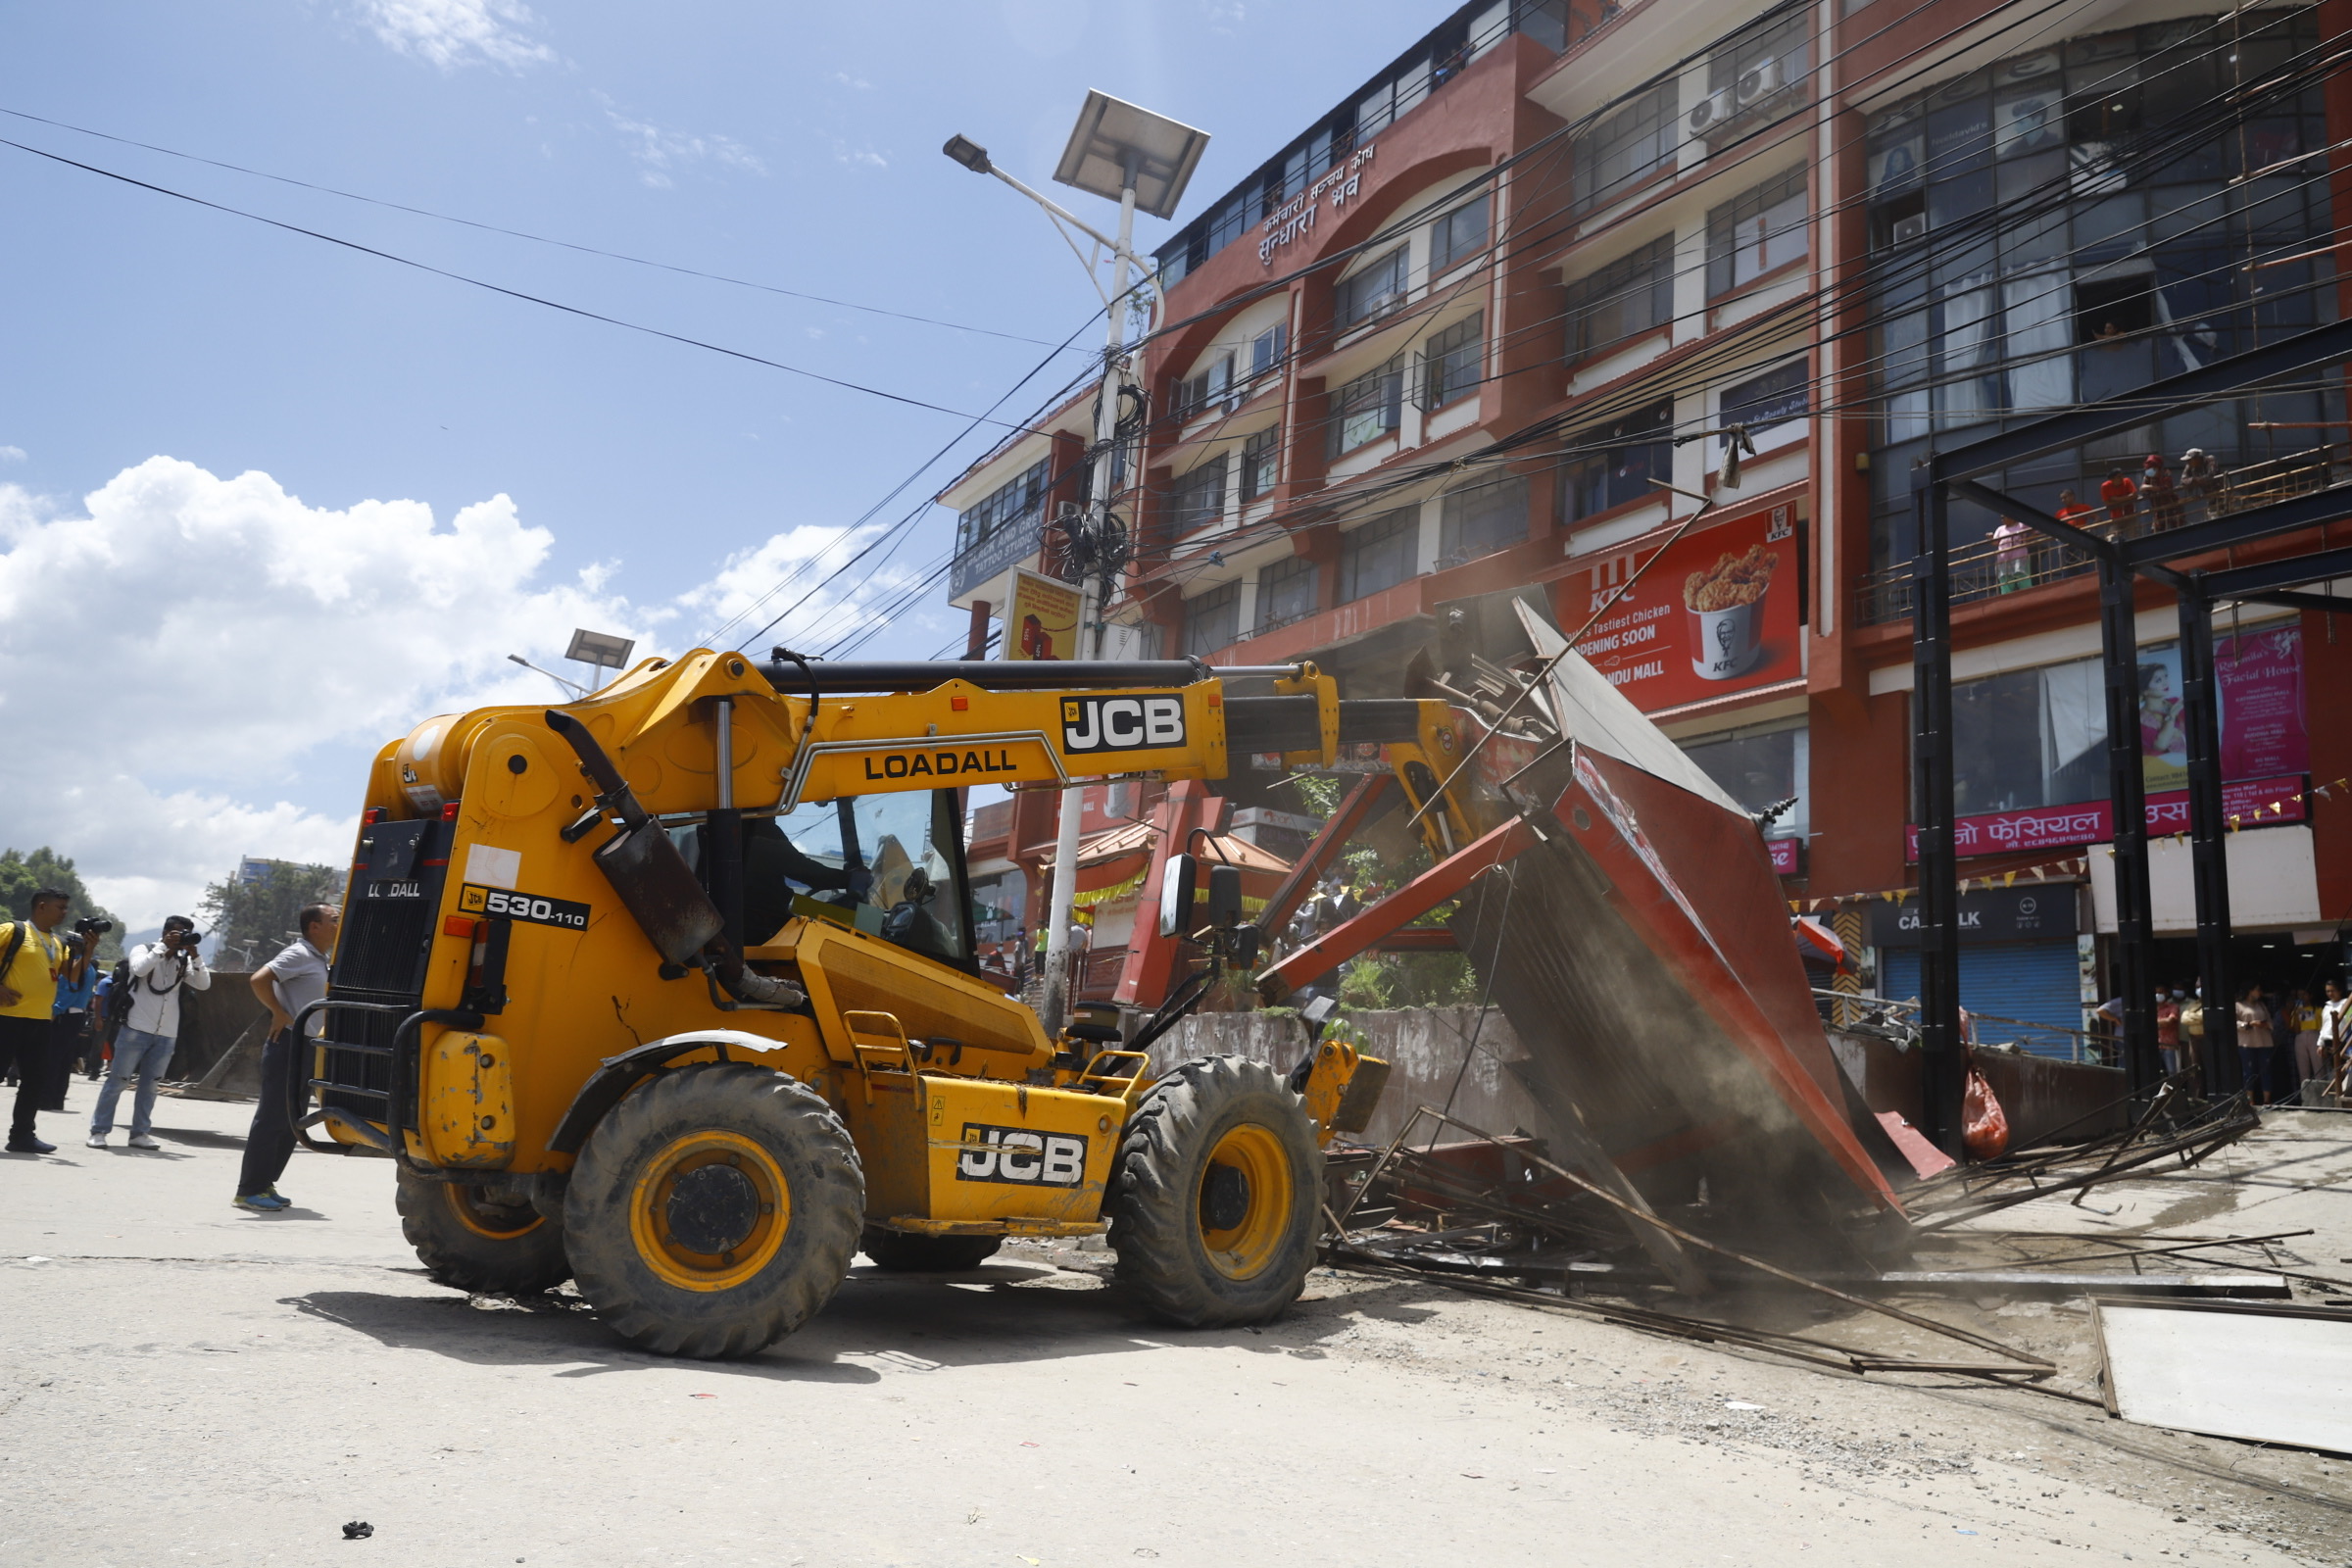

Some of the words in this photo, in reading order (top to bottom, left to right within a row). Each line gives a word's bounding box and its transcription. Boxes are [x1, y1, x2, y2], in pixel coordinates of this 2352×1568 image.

[1263, 193, 1304, 232] कर्मचारी
[1258, 203, 1317, 266] सुन्धारा
[998, 526, 1016, 548] AND
[1018, 508, 1045, 534] GREY
[1771, 529, 1789, 540] KFC
[975, 549, 1003, 575] TATTOO
[1004, 531, 1033, 558] STUDIO
[1593, 614, 1630, 635] Tastiest
[1633, 605, 1670, 623] Chicken
[1622, 624, 1656, 647] SOON
[1634, 660, 1664, 680] MALL
[2221, 668, 2260, 688] Facial
[2263, 666, 2301, 678] House
[1066, 698, 1183, 750] JCB
[864, 750, 1017, 780] LOADALL
[1987, 811, 2101, 841] फेसियल
[368, 883, 420, 898] LDALL
[487, 892, 585, 926] 530-110
[961, 1130, 1084, 1184] JCB
